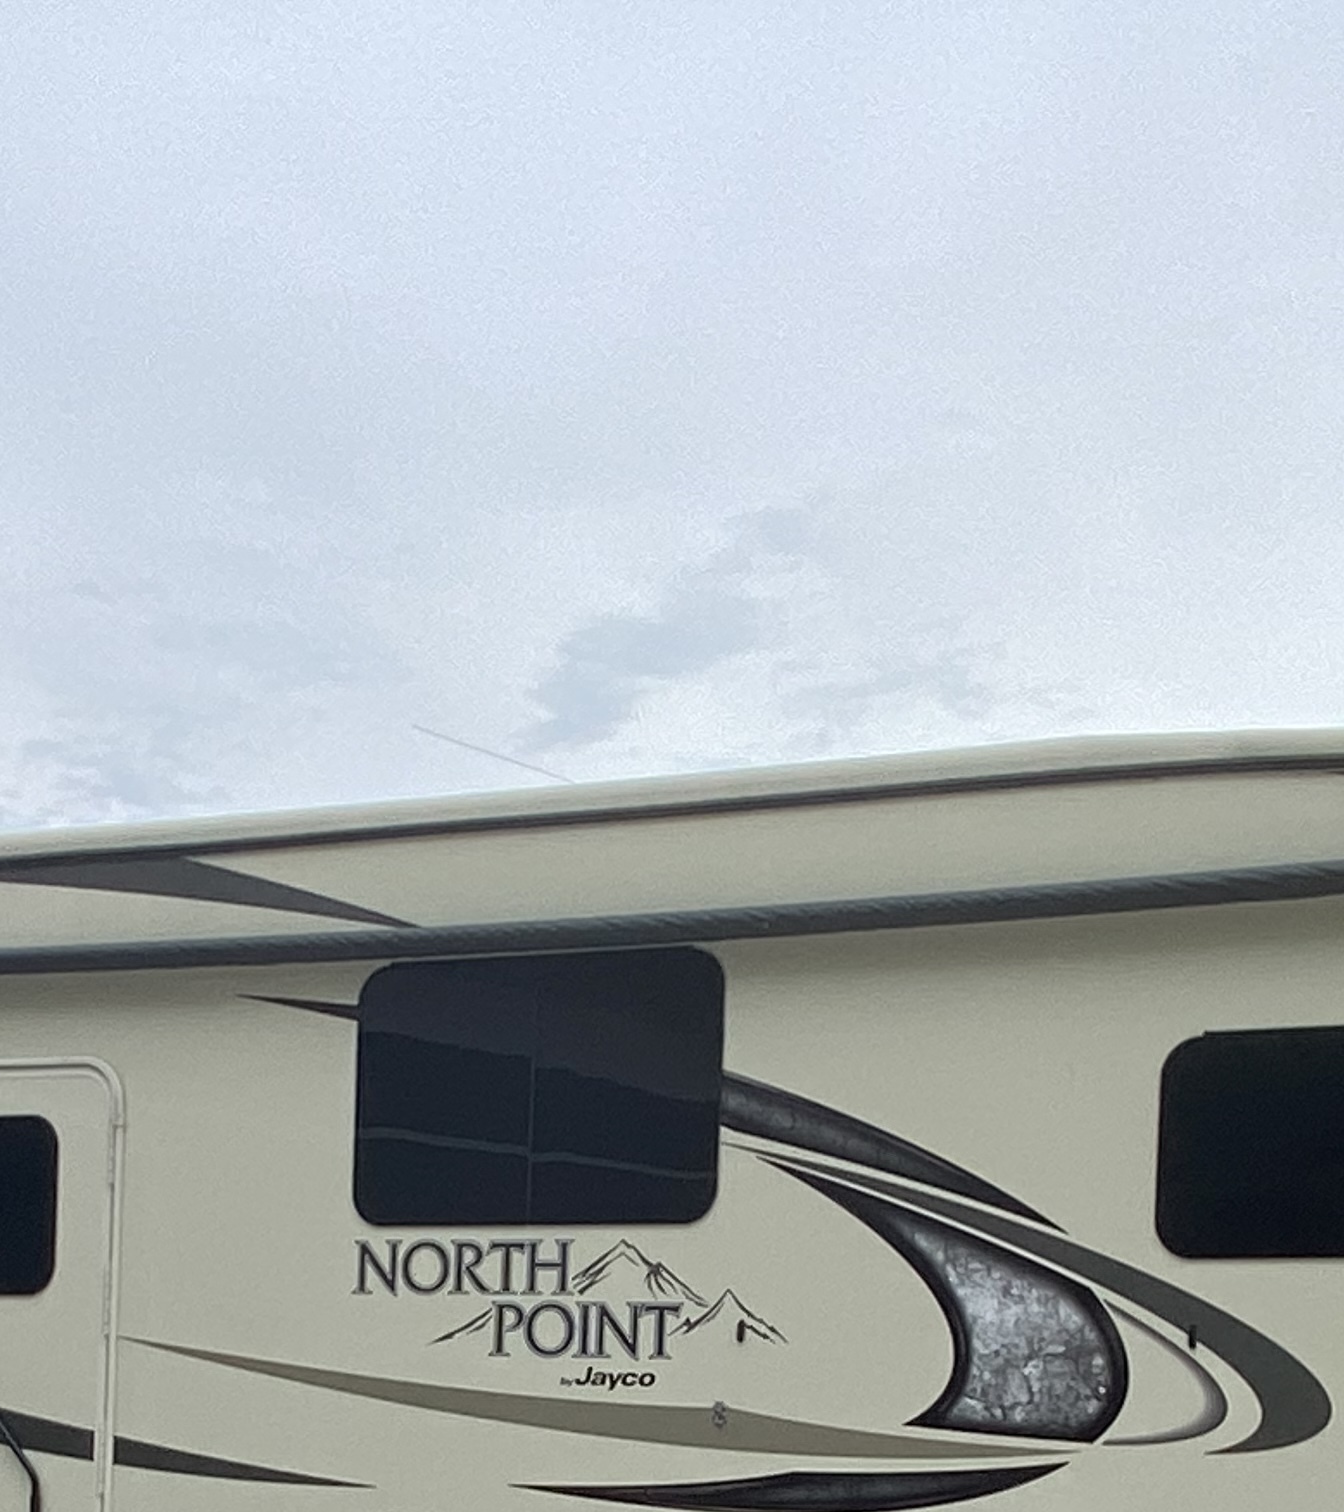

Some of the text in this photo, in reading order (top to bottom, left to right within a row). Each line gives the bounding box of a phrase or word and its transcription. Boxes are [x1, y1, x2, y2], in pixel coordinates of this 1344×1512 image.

[351, 1238, 575, 1296] NORTH
[488, 1300, 684, 1361] POINT
[575, 1366, 656, 1391] Jayco
